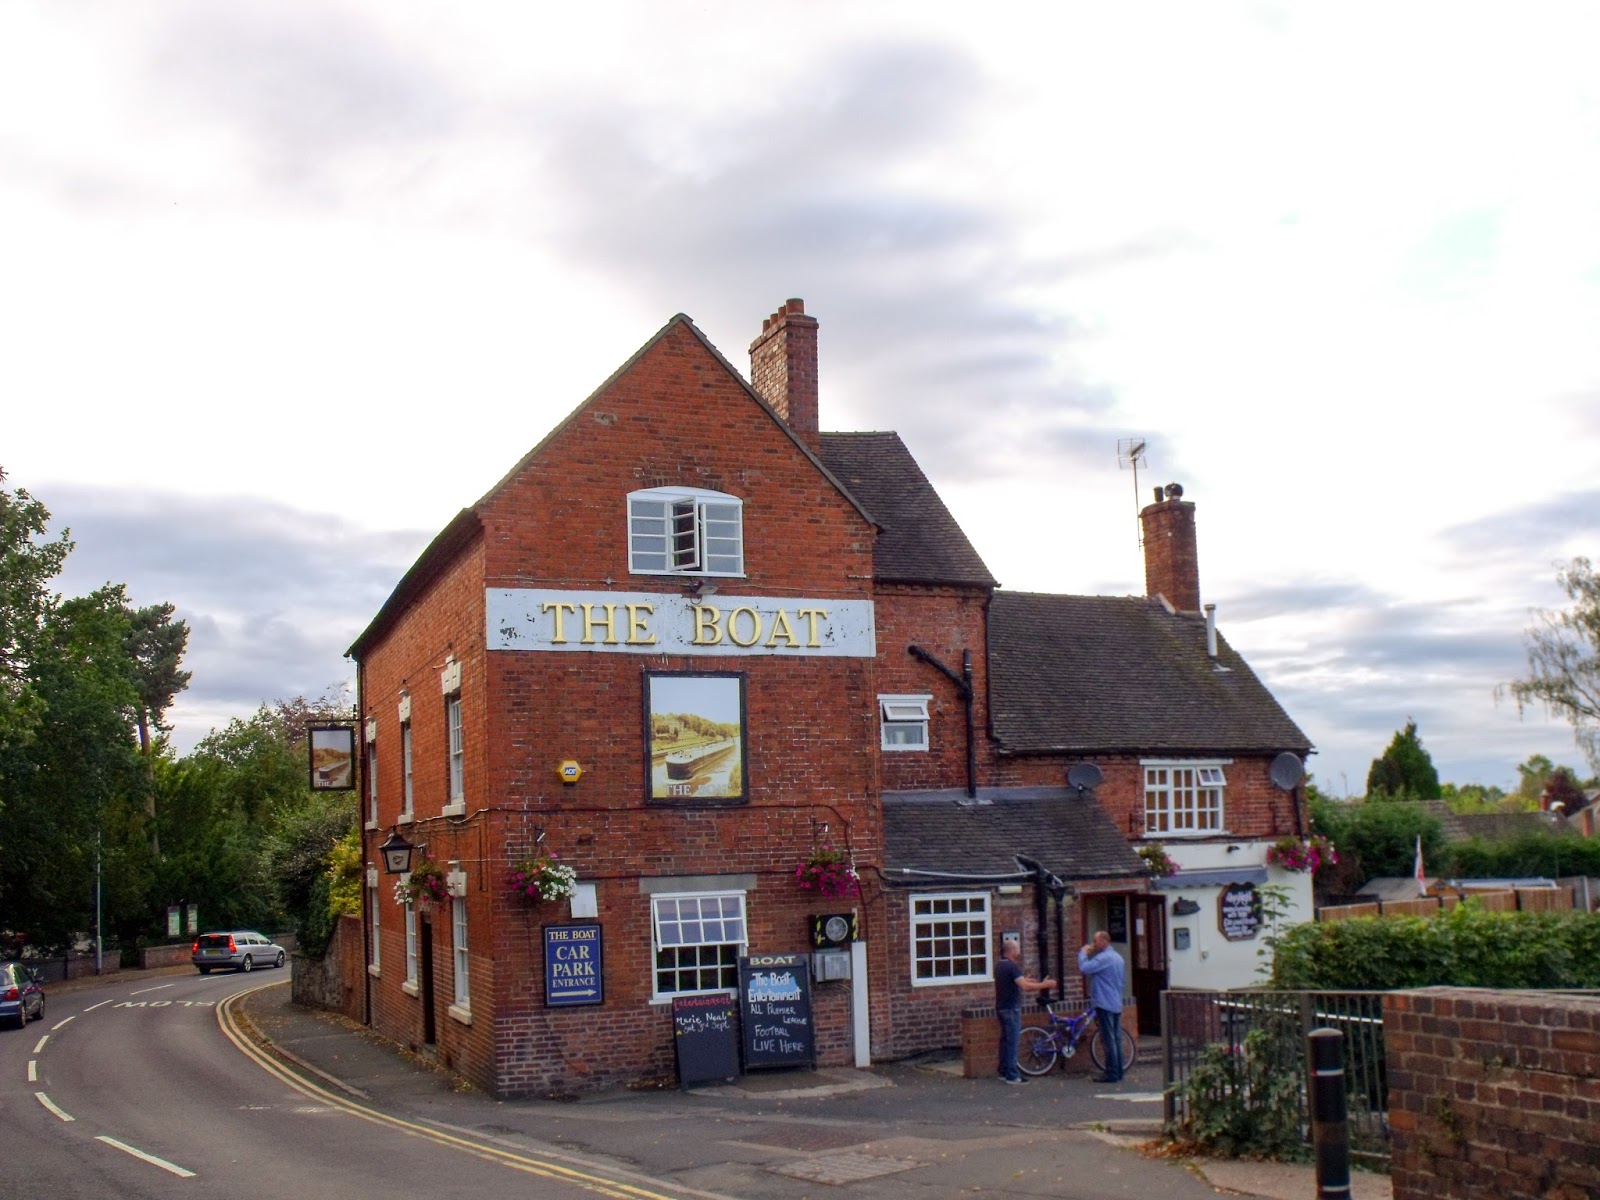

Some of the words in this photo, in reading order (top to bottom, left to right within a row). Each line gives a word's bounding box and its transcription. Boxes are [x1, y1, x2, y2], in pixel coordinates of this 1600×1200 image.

[542, 602, 657, 645] THE
[691, 605, 828, 648] BOAT
[666, 784, 692, 795] THE
[548, 930, 569, 940] THE
[572, 929, 597, 940] BOAT
[556, 945, 590, 960] CAR
[750, 955, 796, 966] BOAT
[552, 961, 595, 977] PARK
[552, 977, 596, 988] ENTRANCE
[770, 971, 791, 987] Boat
